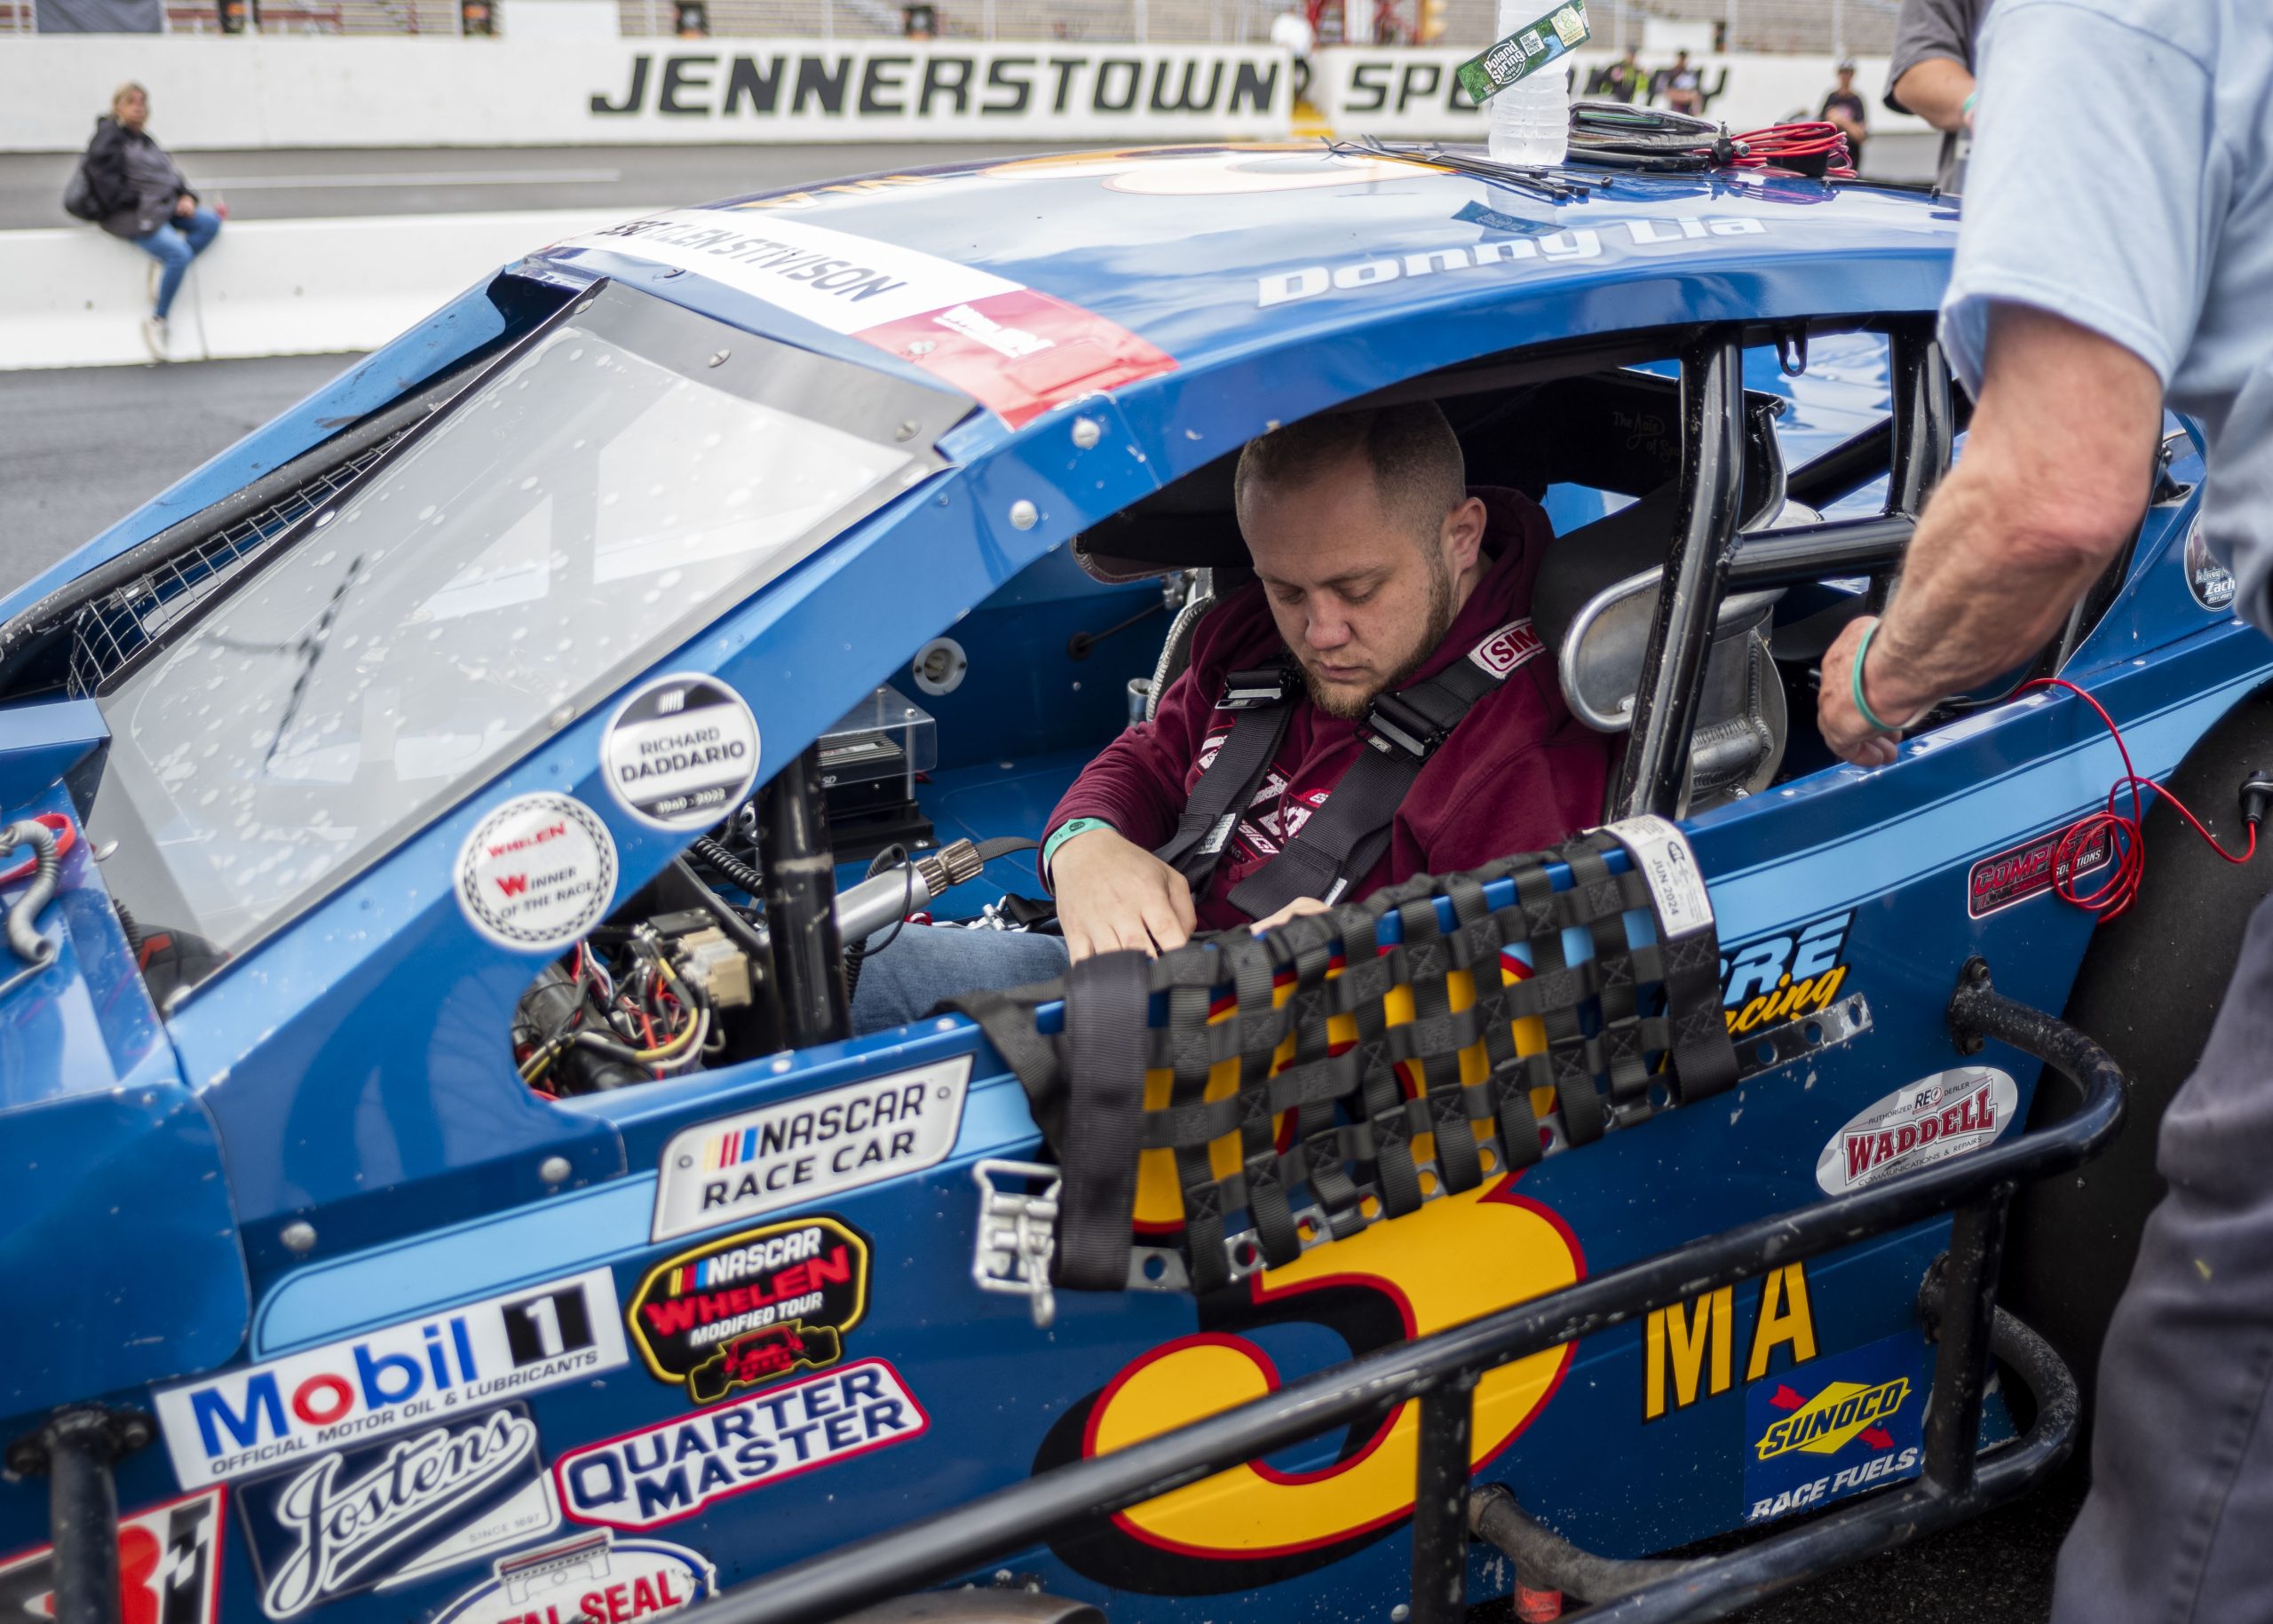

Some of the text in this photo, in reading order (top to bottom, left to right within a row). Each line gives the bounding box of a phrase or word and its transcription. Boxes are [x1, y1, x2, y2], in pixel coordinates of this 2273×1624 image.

[590, 56, 1279, 115] JENNERSTOWN
[1484, 39, 1519, 75] Poland
[1492, 50, 1526, 84] Spring
[709, 237, 909, 302] STIVISON
[1257, 216, 1770, 308] Donny Lia
[2206, 577, 2236, 596] Zach
[1491, 624, 1540, 664] SIM
[621, 741, 745, 783] DADDARIO
[640, 726, 721, 755] RICHARD
[821, 775, 837, 784] SD
[488, 821, 565, 857] WHELEN
[2055, 849, 2102, 876] SOLTIONS
[501, 881, 594, 918] OF THE RACE
[1652, 858, 1668, 883] JUN
[1663, 885, 1679, 915] 2024
[1720, 912, 1853, 1005] RE
[1725, 966, 1846, 1034] cing
[759, 1083, 926, 1158] NASCAR
[1844, 1084, 1996, 1180] WADDELL
[1868, 1104, 1913, 1125] AUTHORIZED
[1944, 1081, 1970, 1097] DEALER
[702, 1129, 917, 1210] RACE CAR
[1857, 1153, 1941, 1186] COMMUNICATIONS
[1952, 1136, 1983, 1152] REPAIRS
[707, 1227, 822, 1286] NASCAR
[643, 1245, 851, 1336] WHELEN
[690, 1290, 823, 1348] MODIFIED TOUR
[1642, 1260, 1820, 1424] MA
[190, 1295, 565, 1459] Mobil 1
[210, 1350, 598, 1476] OFFICIAL MOTOR OIL & LUBRICANTS
[567, 1367, 884, 1504] QUARTER
[1762, 1382, 1906, 1454] SUNOCO
[634, 1396, 909, 1519] MASTER
[1750, 1447, 1918, 1521] RACE FUELS
[265, 1410, 522, 1620] Jostens
[469, 1522, 509, 1543] SINCE
[580, 1570, 683, 1624] SEAL
